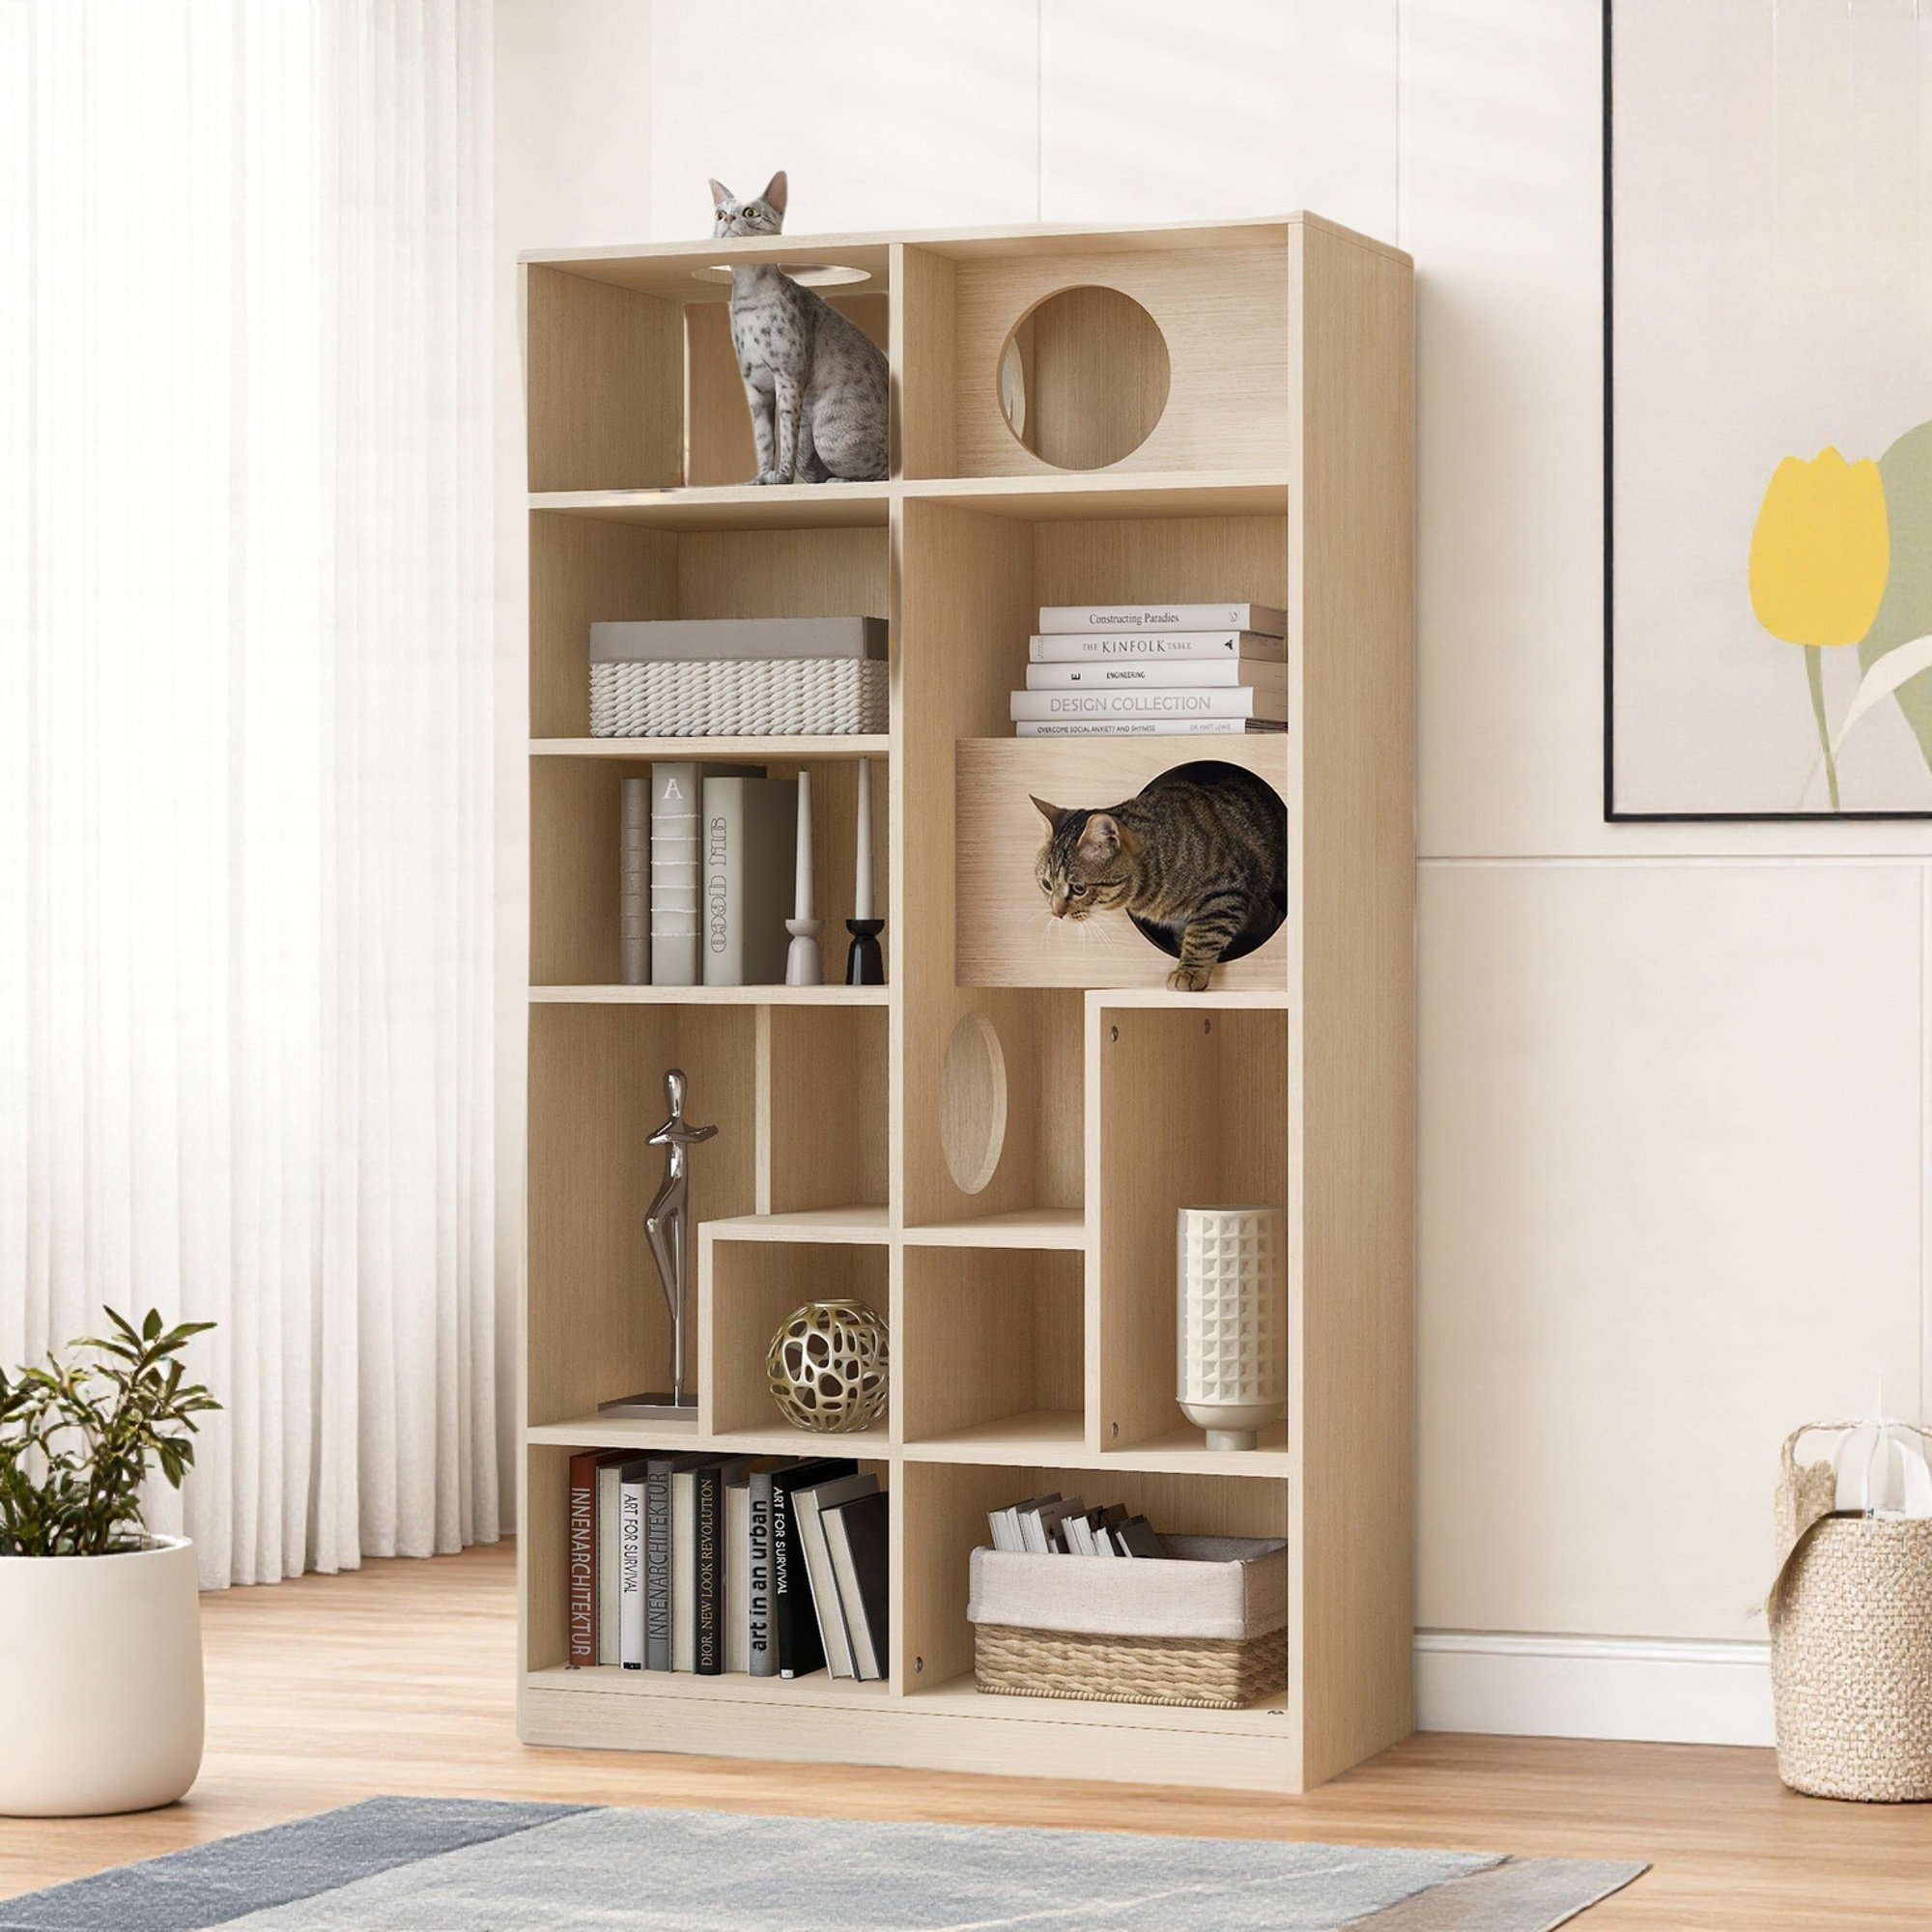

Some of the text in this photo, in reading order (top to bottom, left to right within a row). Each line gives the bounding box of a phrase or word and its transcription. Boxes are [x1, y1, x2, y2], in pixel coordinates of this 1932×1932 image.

[1089, 611, 1179, 626] Constructing Paradies
[1102, 639, 1166, 653] KINFOLK
[1167, 641, 1192, 651] TABLE
[1050, 696, 1211, 713] DESIGN COLLECTION
[1106, 670, 1146, 679] ENGINEERING
[662, 779, 684, 800] A
[571, 1488, 591, 1656] INNENARCHITEKTUR
[623, 1493, 639, 1593] ART FOR SURVIVAL
[648, 1472, 668, 1641] INNENARCHITEKTUR
[700, 1478, 713, 1667] DIOR. NEW LOOK REVOLUTION
[749, 1500, 768, 1651] art in an urban
[773, 1487, 788, 1595] ART FOR SURVIVAL
